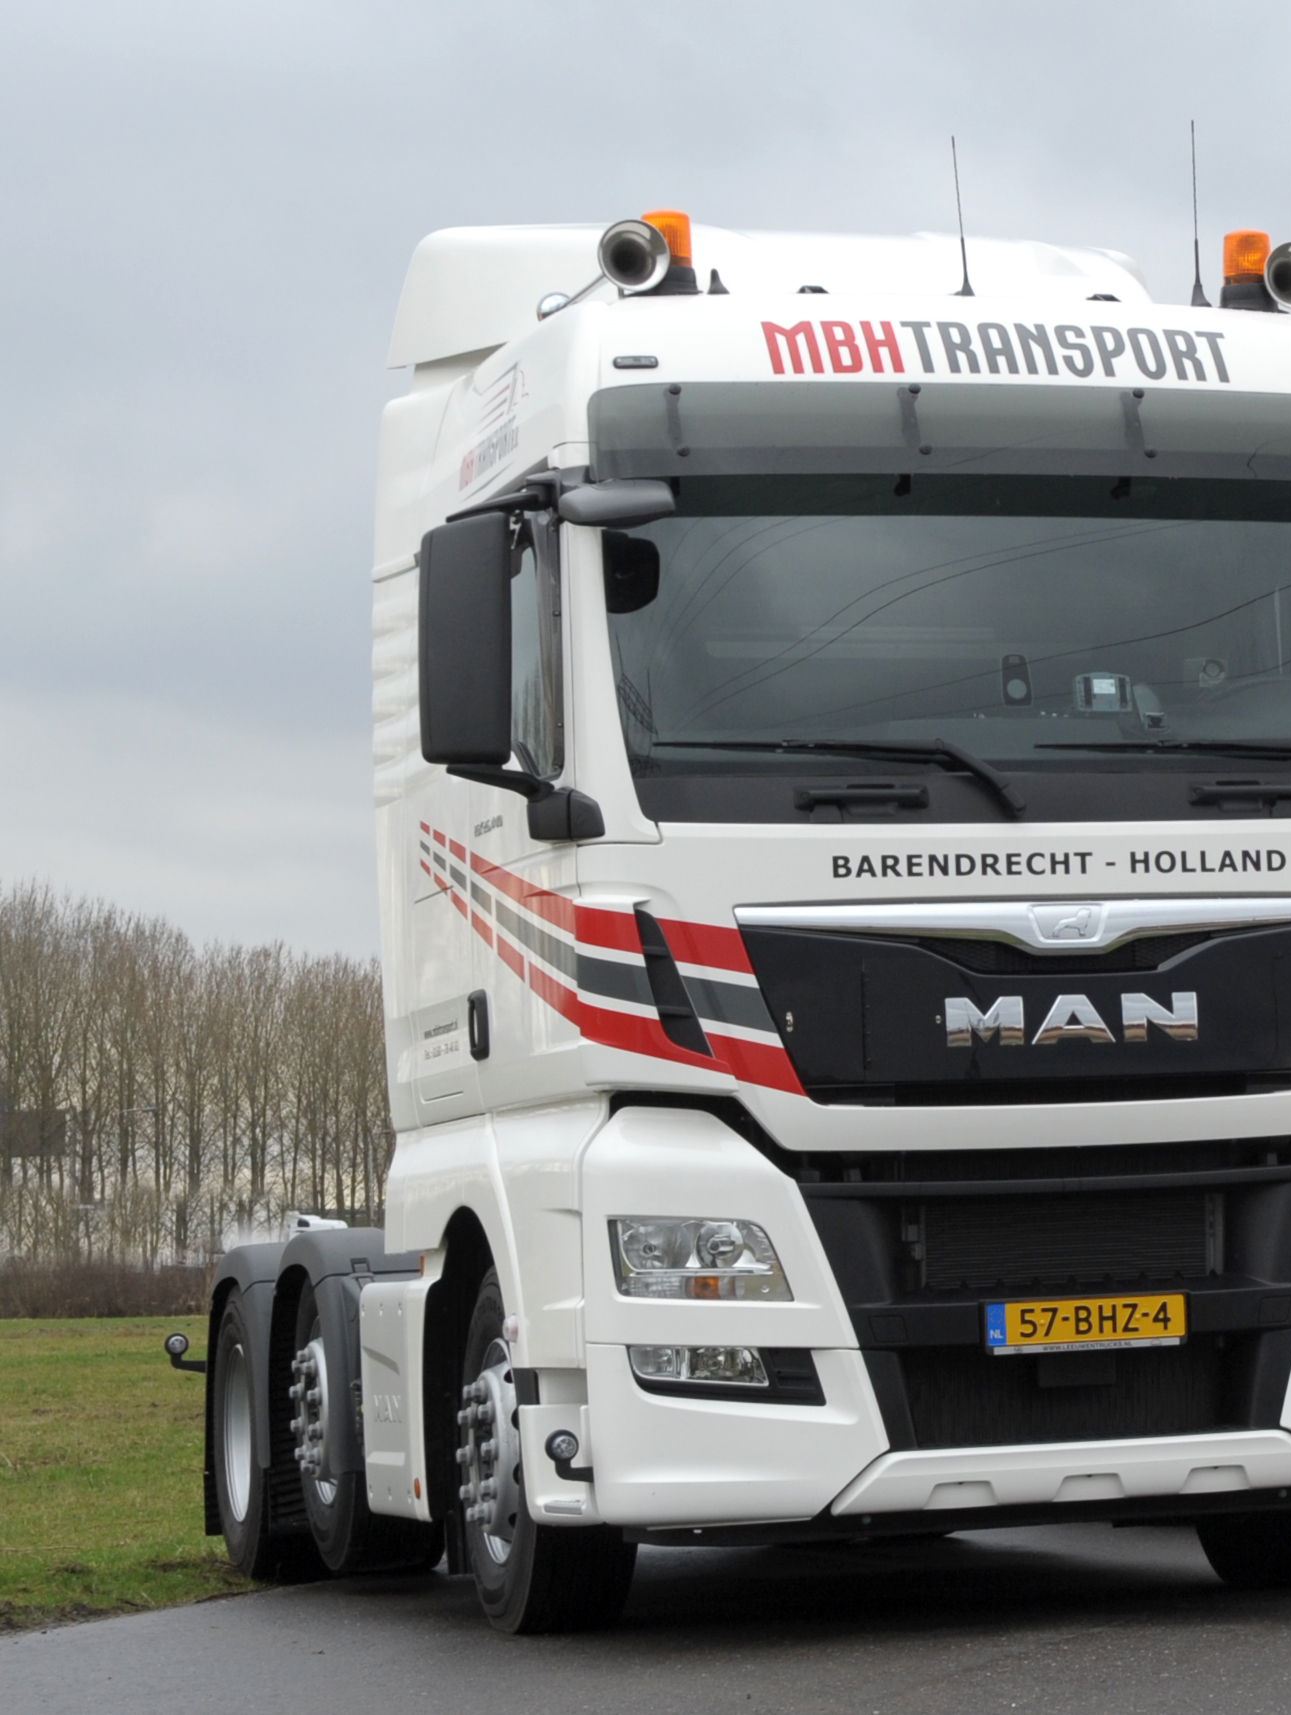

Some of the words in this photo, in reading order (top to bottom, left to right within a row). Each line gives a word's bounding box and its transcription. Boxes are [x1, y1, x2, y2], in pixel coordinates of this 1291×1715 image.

[831, 851, 1093, 878] BARENDRECHT
[1129, 849, 1287, 874] HOLLAND
[944, 991, 1199, 1047] MAN
[989, 1329, 1004, 1339] NL
[1019, 1301, 1172, 1338] 57-BHZ-4
